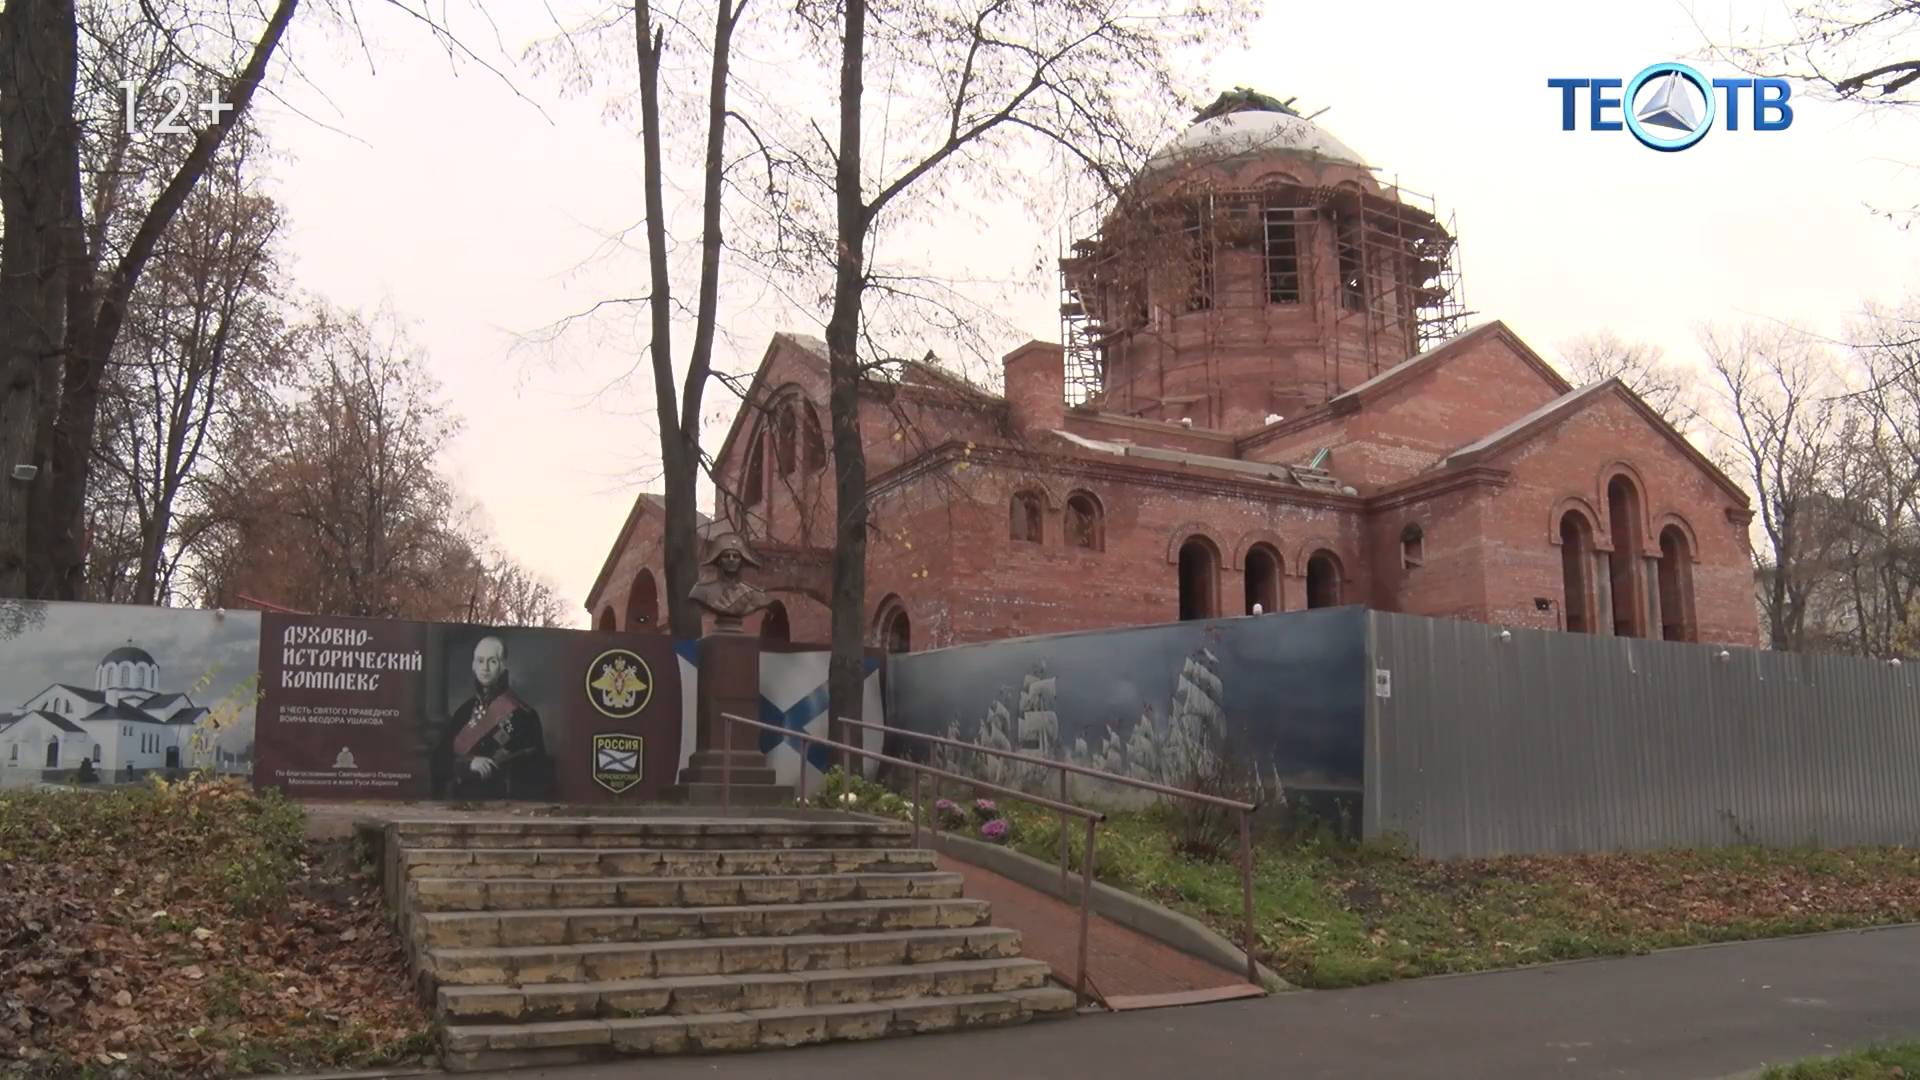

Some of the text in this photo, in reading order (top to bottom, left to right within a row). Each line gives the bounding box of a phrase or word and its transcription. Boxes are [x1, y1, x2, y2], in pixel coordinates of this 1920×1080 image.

[283, 626, 374, 646] ДУХОВНО-
[283, 648, 422, 671] ИСТОРИЧЕСКИЙ
[281, 670, 380, 691] КОМПЛЕКС
[279, 706, 400, 717] В ЧЕСТЬ СВЯТОГО ПРАВЕДНОГО
[279, 715, 384, 726] ВОИНА ФЕОДОРА УШАКОВА
[598, 739, 639, 750] РОССИЯ
